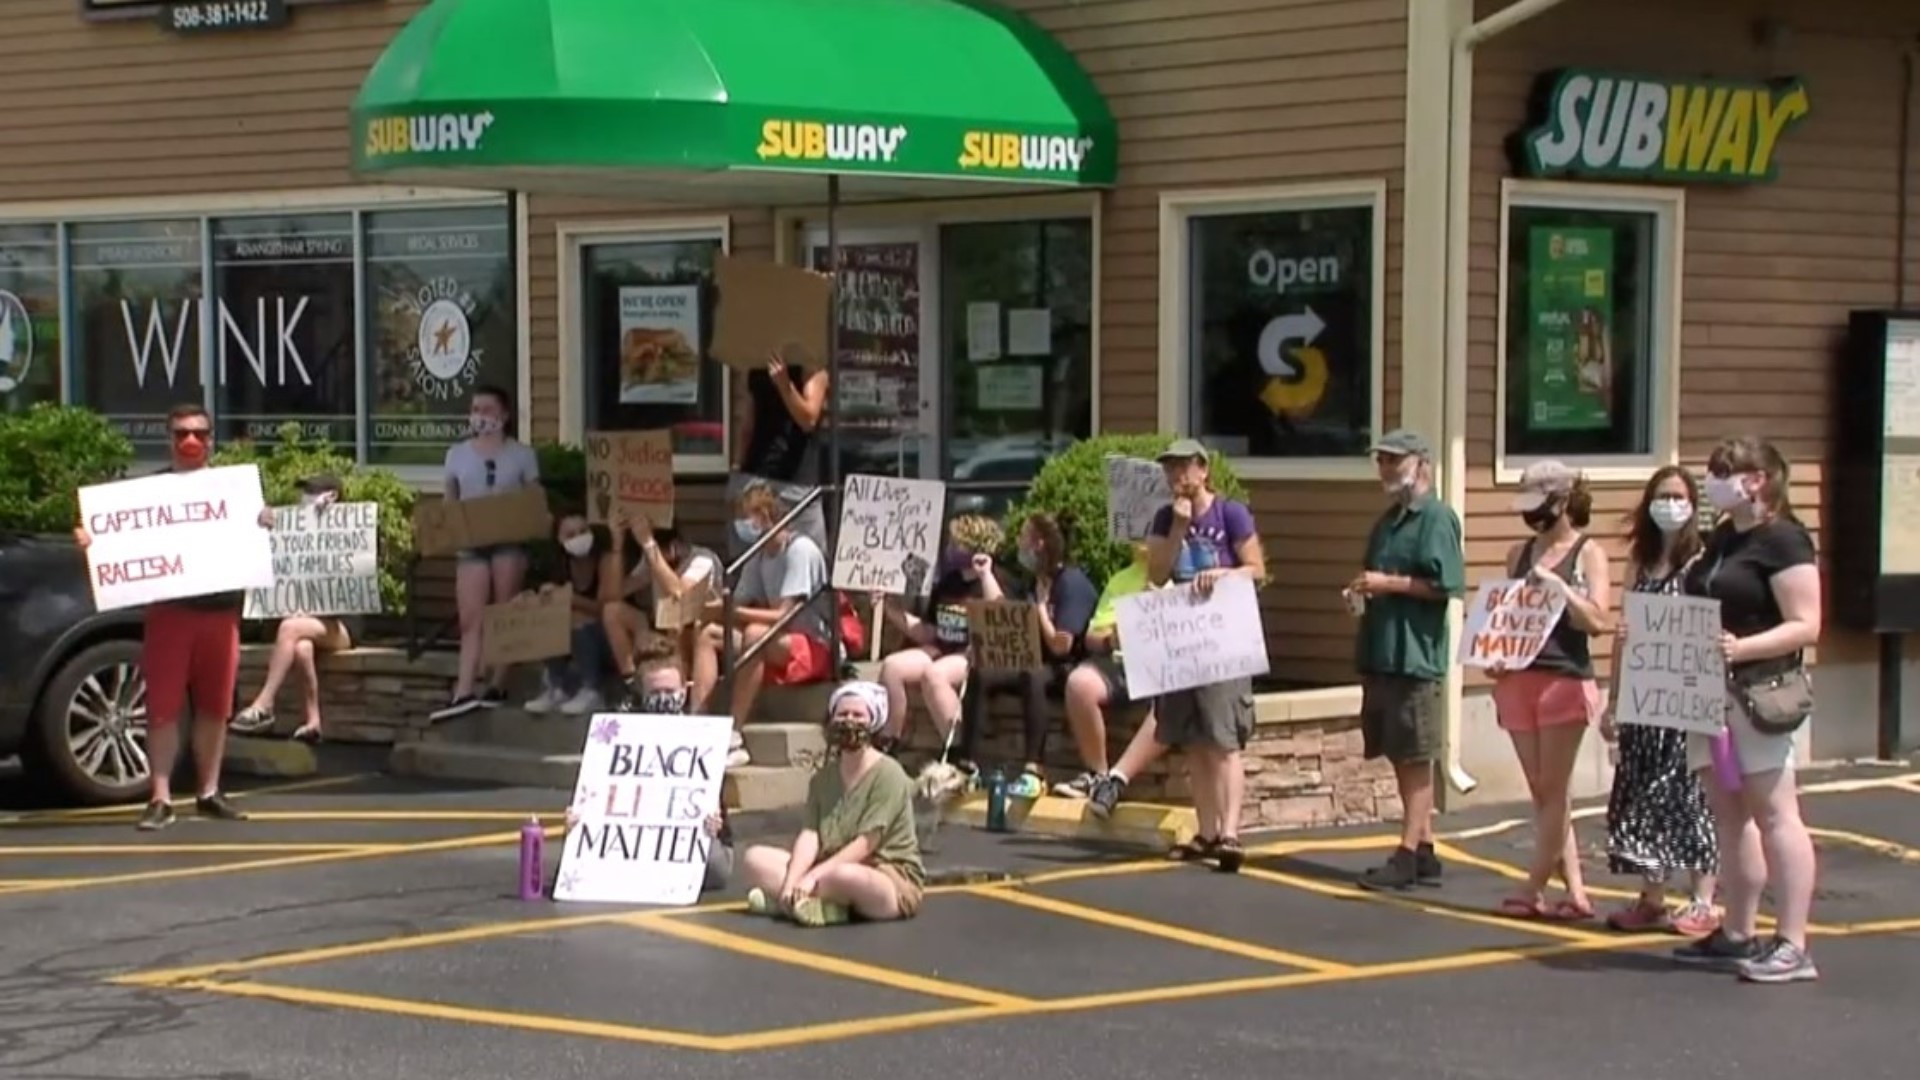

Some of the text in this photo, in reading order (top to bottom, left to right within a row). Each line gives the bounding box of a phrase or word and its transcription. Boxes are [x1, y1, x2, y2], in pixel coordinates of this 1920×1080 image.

[172, 1, 269, 28] 508-381-1422
[366, 111, 495, 158] SUBWAY
[757, 120, 907, 162] SUBWAY
[1535, 75, 1808, 176] SUBWAY
[959, 132, 1094, 171] SUBWAY
[1248, 249, 1340, 294] Open
[121, 297, 312, 388] WINK
[407, 347, 448, 400] SALON
[463, 348, 486, 385] SPA
[588, 438, 610, 460] NO
[847, 476, 911, 502] All Lives
[90, 499, 228, 535] CAPITALISM
[315, 504, 374, 529] PEOPLE
[281, 533, 315, 554] YOUR
[317, 530, 369, 551] FRIENDS
[863, 520, 928, 552] BLACK
[97, 554, 184, 586] RACISM
[298, 552, 354, 574] FAMILIES
[848, 562, 901, 587] Matter
[1485, 585, 1558, 614] BLACK
[1137, 611, 1225, 643] Silence
[1490, 611, 1547, 632] LIVES
[1644, 603, 1716, 641] WHITE
[1627, 640, 1722, 678] SILENCE
[1631, 685, 1723, 726] VIOLENCE
[608, 744, 713, 781] BLACK
[604, 783, 706, 820] LIES
